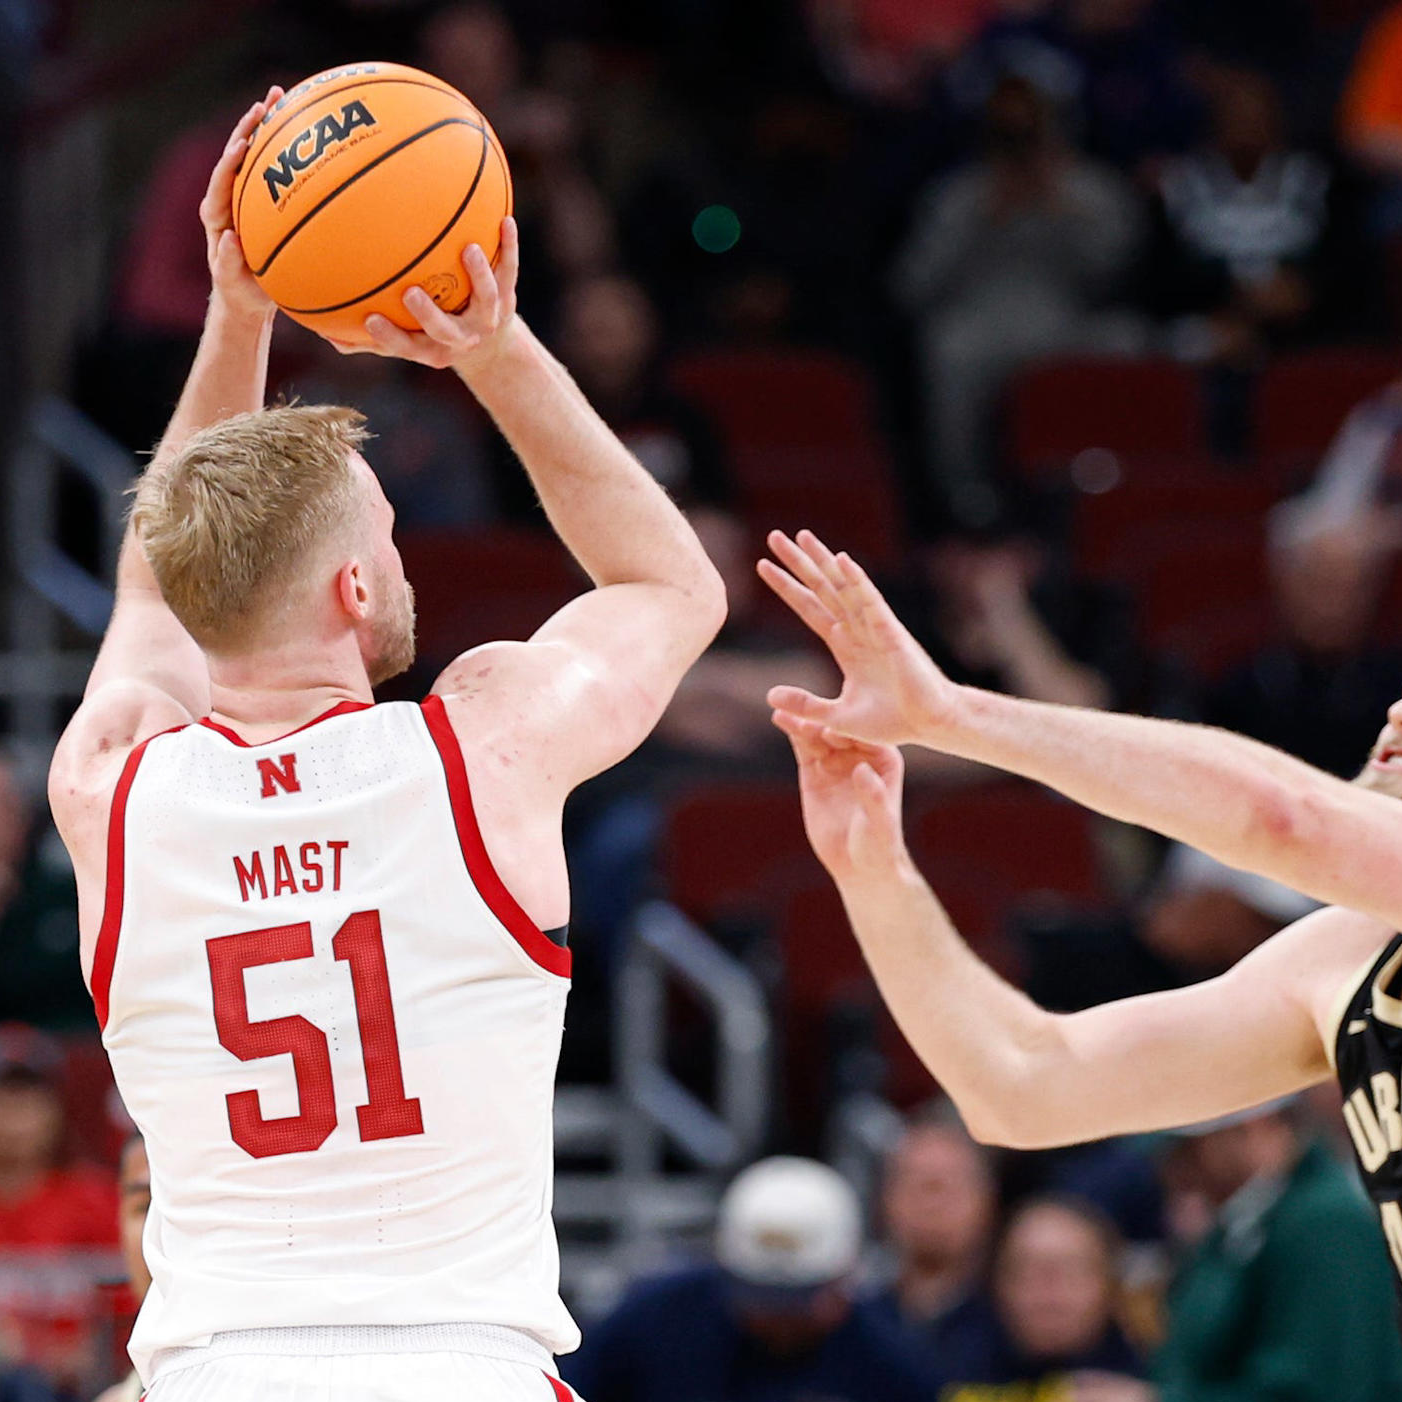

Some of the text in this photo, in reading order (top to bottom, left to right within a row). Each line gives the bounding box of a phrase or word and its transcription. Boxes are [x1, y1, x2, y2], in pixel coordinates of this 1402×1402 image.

[262, 99, 377, 204] NCAA
[256, 753, 302, 799] N
[233, 840, 349, 902] MAST
[205, 909, 425, 1159] 51
